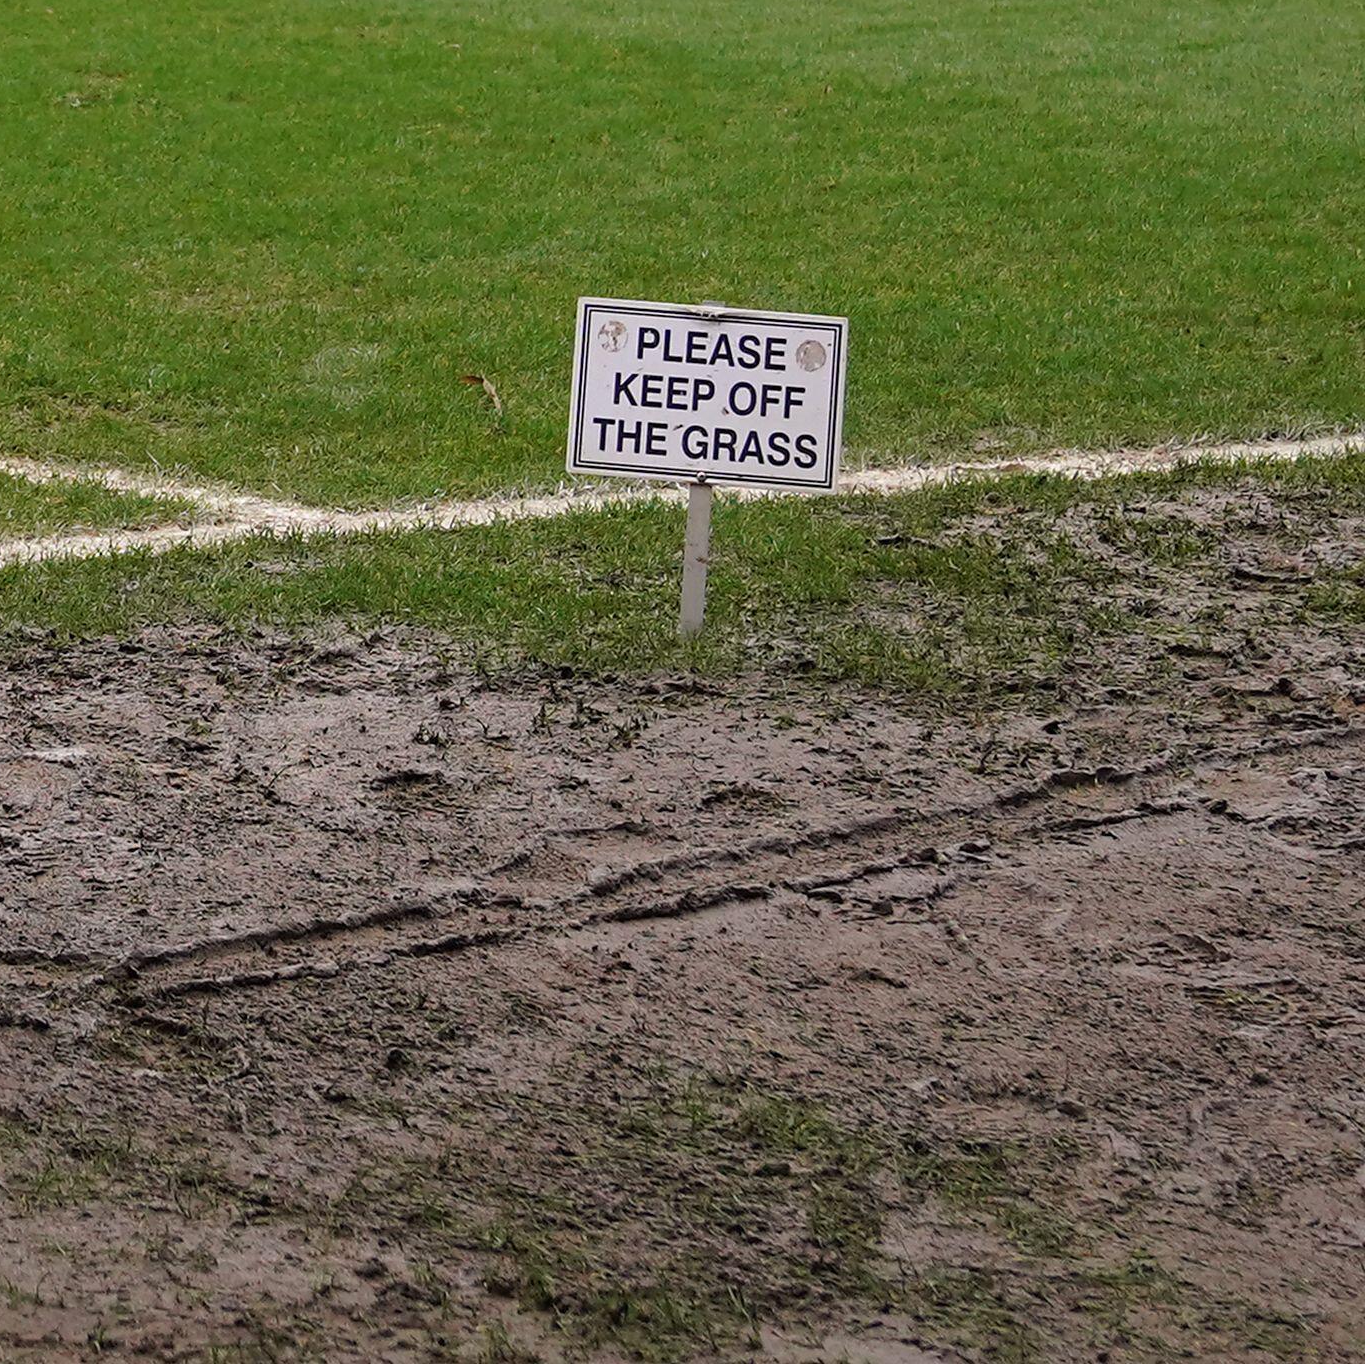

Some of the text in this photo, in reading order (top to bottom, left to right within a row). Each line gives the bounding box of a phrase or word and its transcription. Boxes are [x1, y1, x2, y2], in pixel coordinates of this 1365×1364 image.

[636, 326, 788, 371] PLEASE
[613, 372, 807, 419] KEEP OFF
[592, 417, 818, 469] THE GRASS
